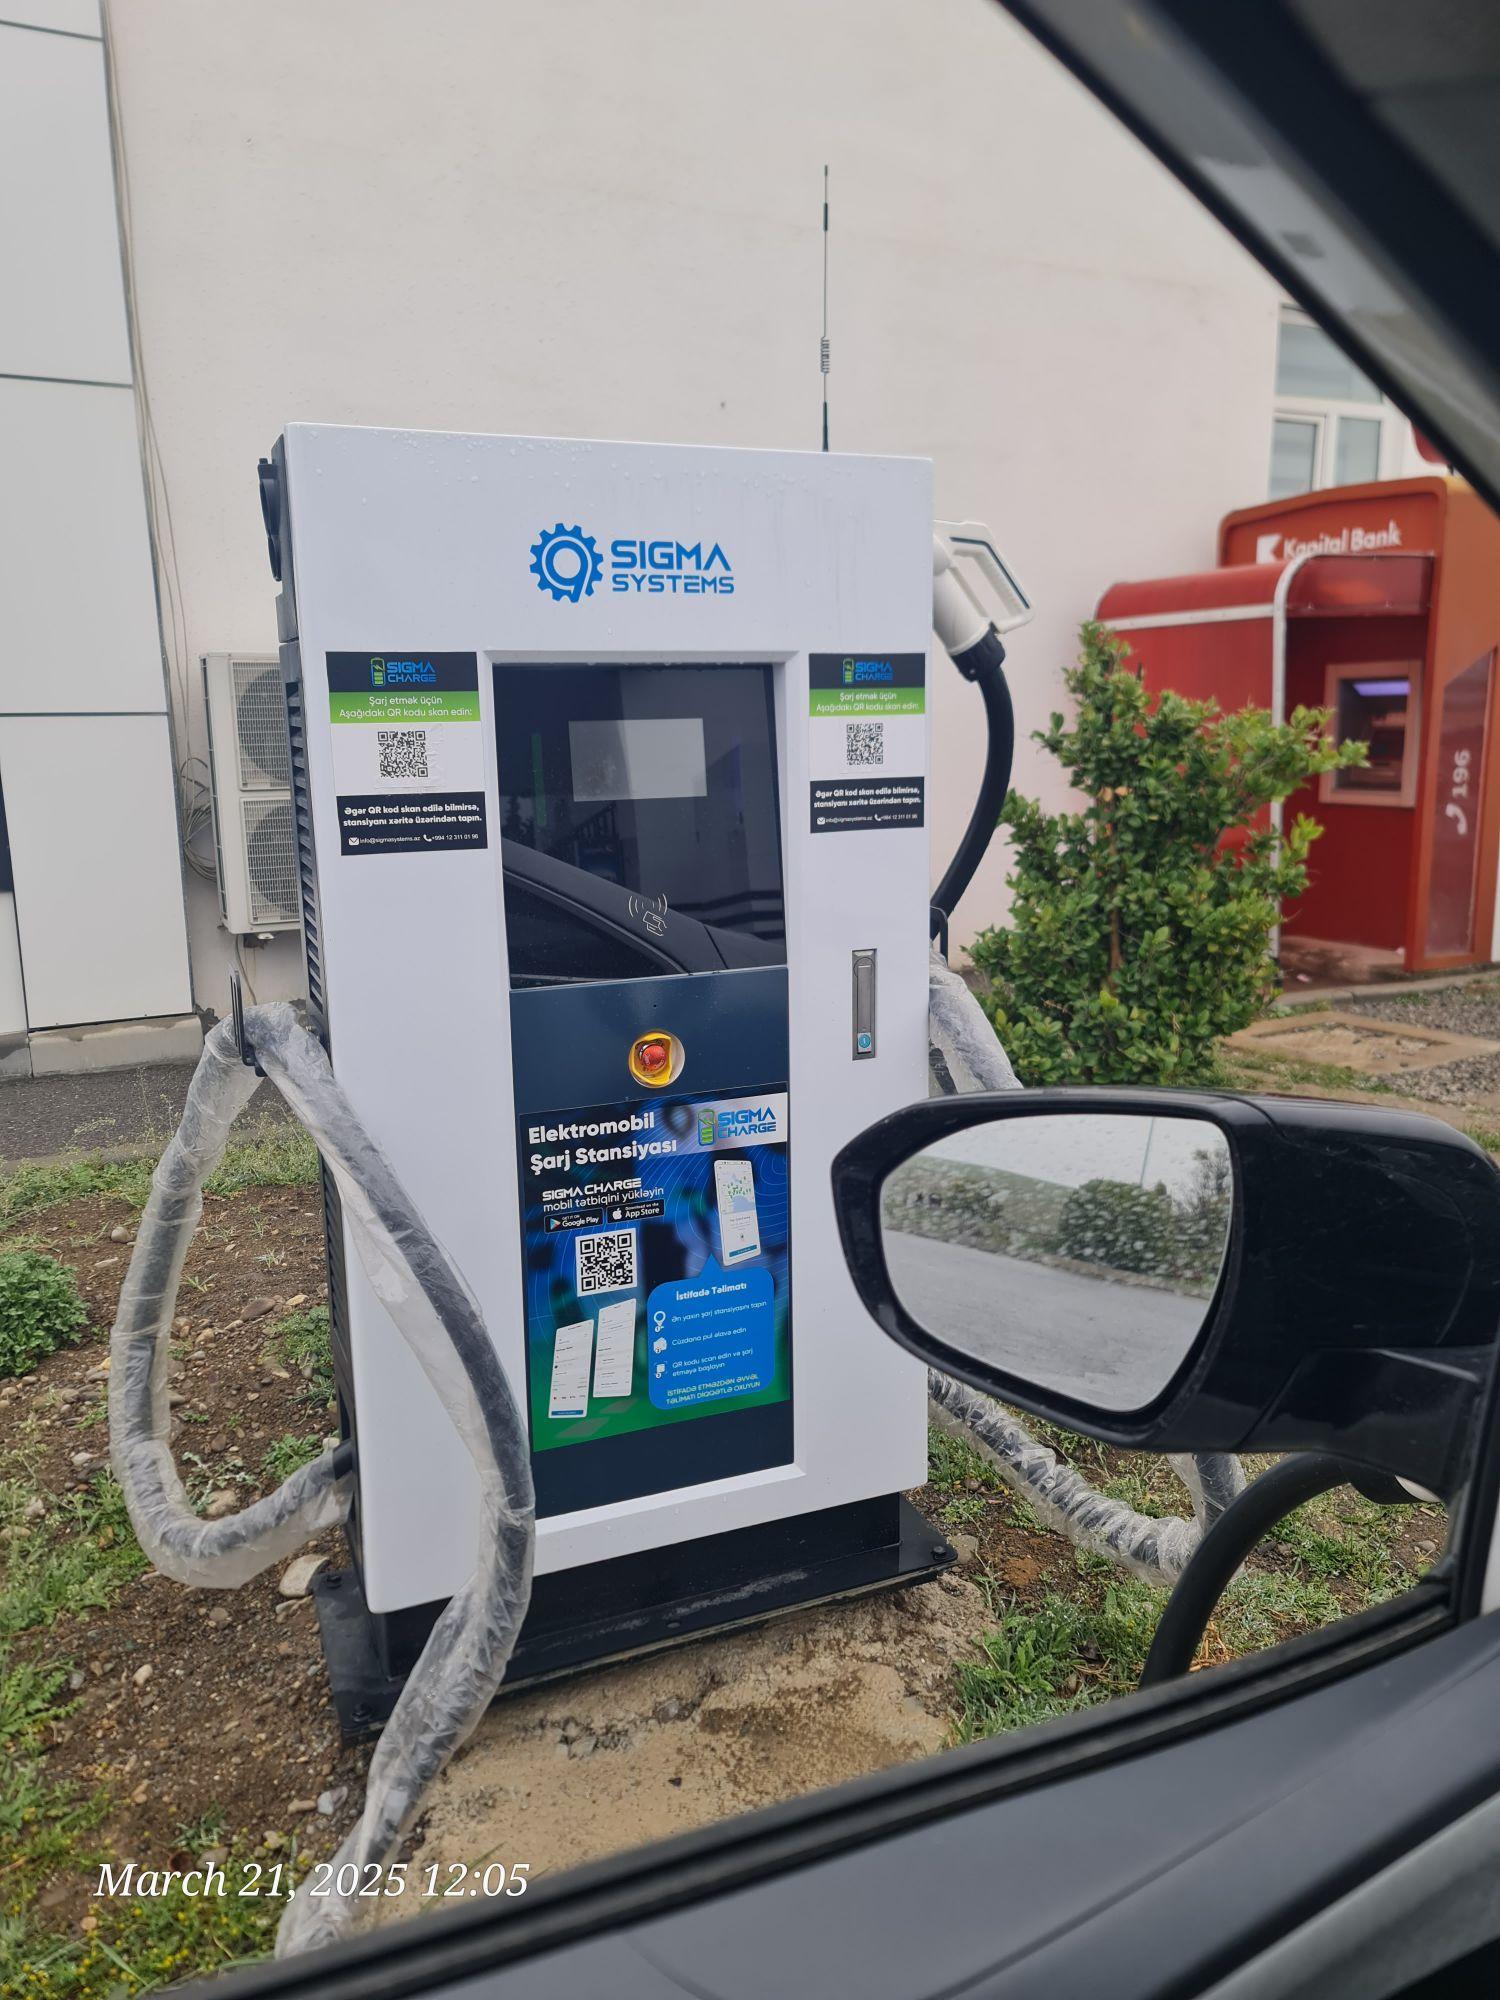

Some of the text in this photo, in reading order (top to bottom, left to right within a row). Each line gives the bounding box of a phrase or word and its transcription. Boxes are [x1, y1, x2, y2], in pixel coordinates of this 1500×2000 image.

[1350, 519, 1402, 551] Bank
[611, 540, 732, 571] SIGMA
[612, 574, 734, 593] SYSTEMS
[387, 661, 435, 673] SIGMA
[855, 661, 893, 672] SIGMA
[387, 674, 437, 683] CHARGE
[855, 673, 893, 681] CHARGE
[369, 696, 443, 707] Şarj etmək üçün
[340, 709, 385, 719] Aşağıdakı
[387, 709, 401, 718] QR
[403, 708, 426, 717] kodu
[428, 708, 449, 717] skan
[1452, 748, 1471, 799] 196
[846, 788, 858, 796] kod
[344, 802, 480, 817] Əgər QR kod skan edilə bilmirsə,
[343, 817, 388, 827] stansiyanı
[388, 816, 414, 825] xəritə
[415, 814, 457, 824] üzərindən
[717, 1106, 776, 1128] SIGMA
[528, 1111, 655, 1145] Elektromobil
[717, 1122, 777, 1139] CHARGE
[530, 1139, 678, 1176] Şarj Stansiyası
[542, 1177, 642, 1202] SIGMA CHARGE
[543, 1186, 665, 1213] mobil tətbiqini yükləyin
[625, 1206, 660, 1219] App Store
[562, 1216, 600, 1228] Google Play
[675, 1282, 747, 1301] İstifadə Təlimatı
[672, 1361, 684, 1369] QR
